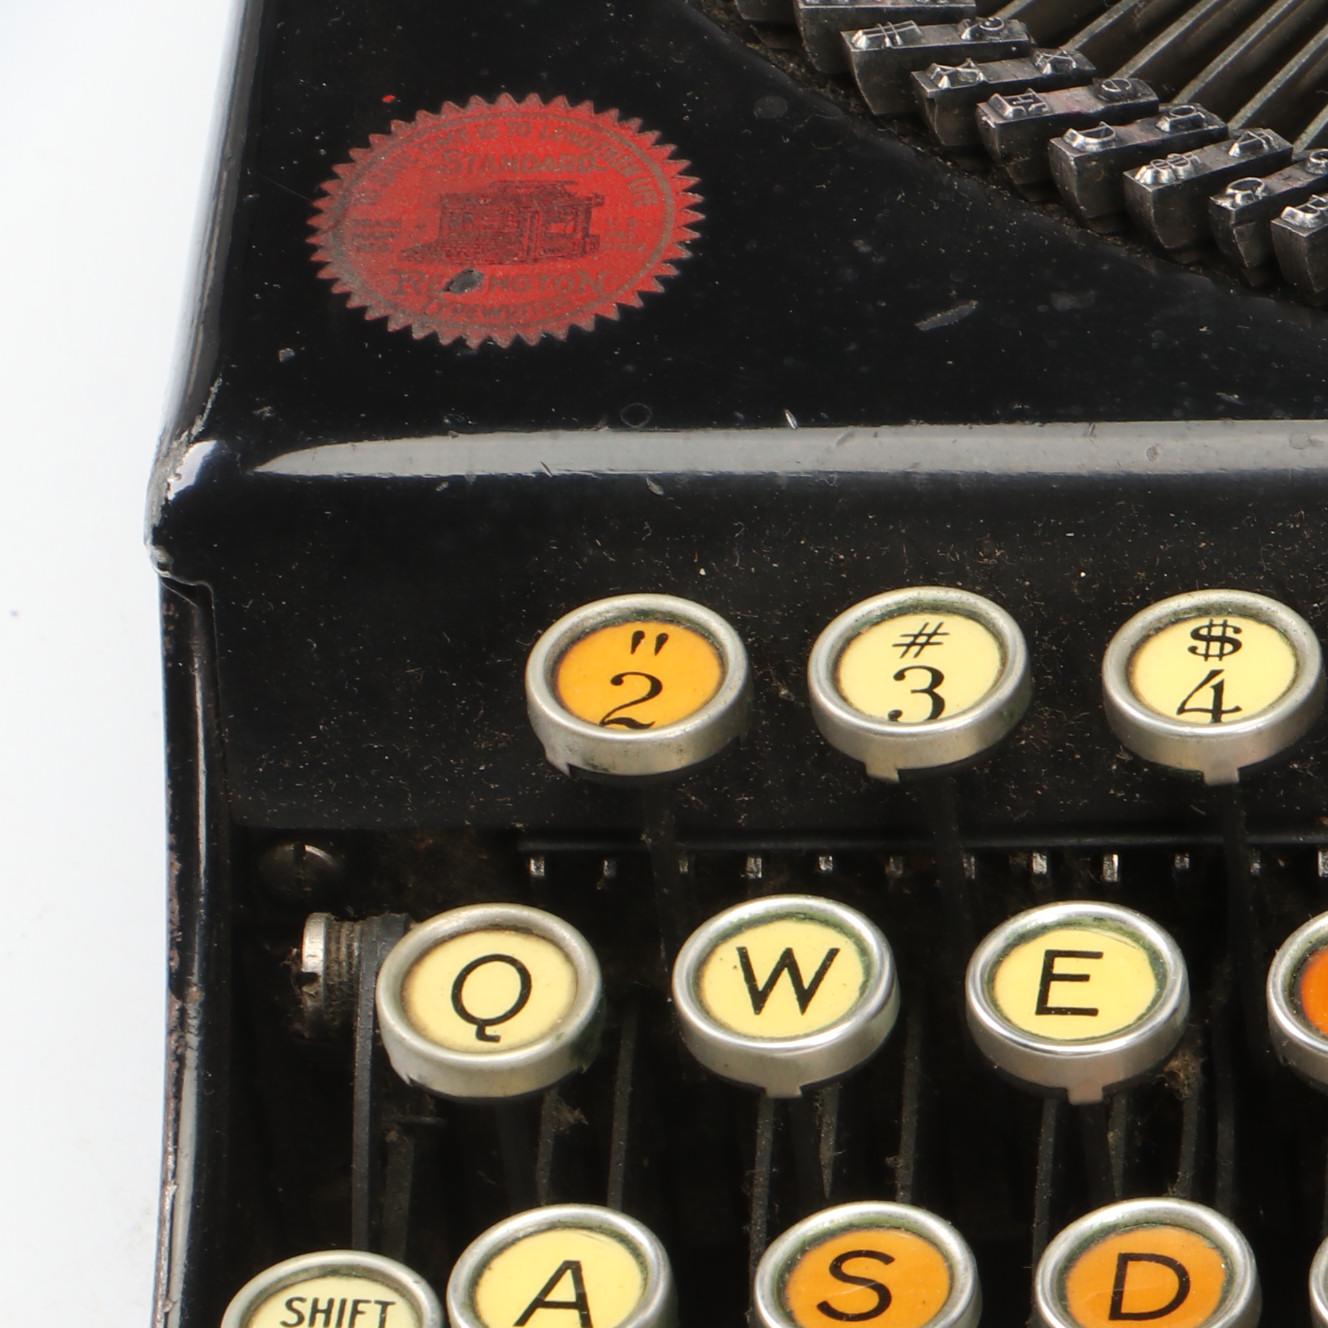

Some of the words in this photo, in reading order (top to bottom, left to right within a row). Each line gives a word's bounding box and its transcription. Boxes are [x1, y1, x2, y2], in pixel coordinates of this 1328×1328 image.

[892, 621, 949, 659] #
[1187, 618, 1242, 662] $
[598, 671, 663, 731] 2
[887, 665, 946, 723] 3
[1176, 669, 1242, 725] 4
[450, 953, 532, 1043] Q
[736, 946, 840, 1015] W
[1035, 949, 1103, 1017] E
[816, 1249, 895, 1322] S
[1108, 1252, 1191, 1321] D
